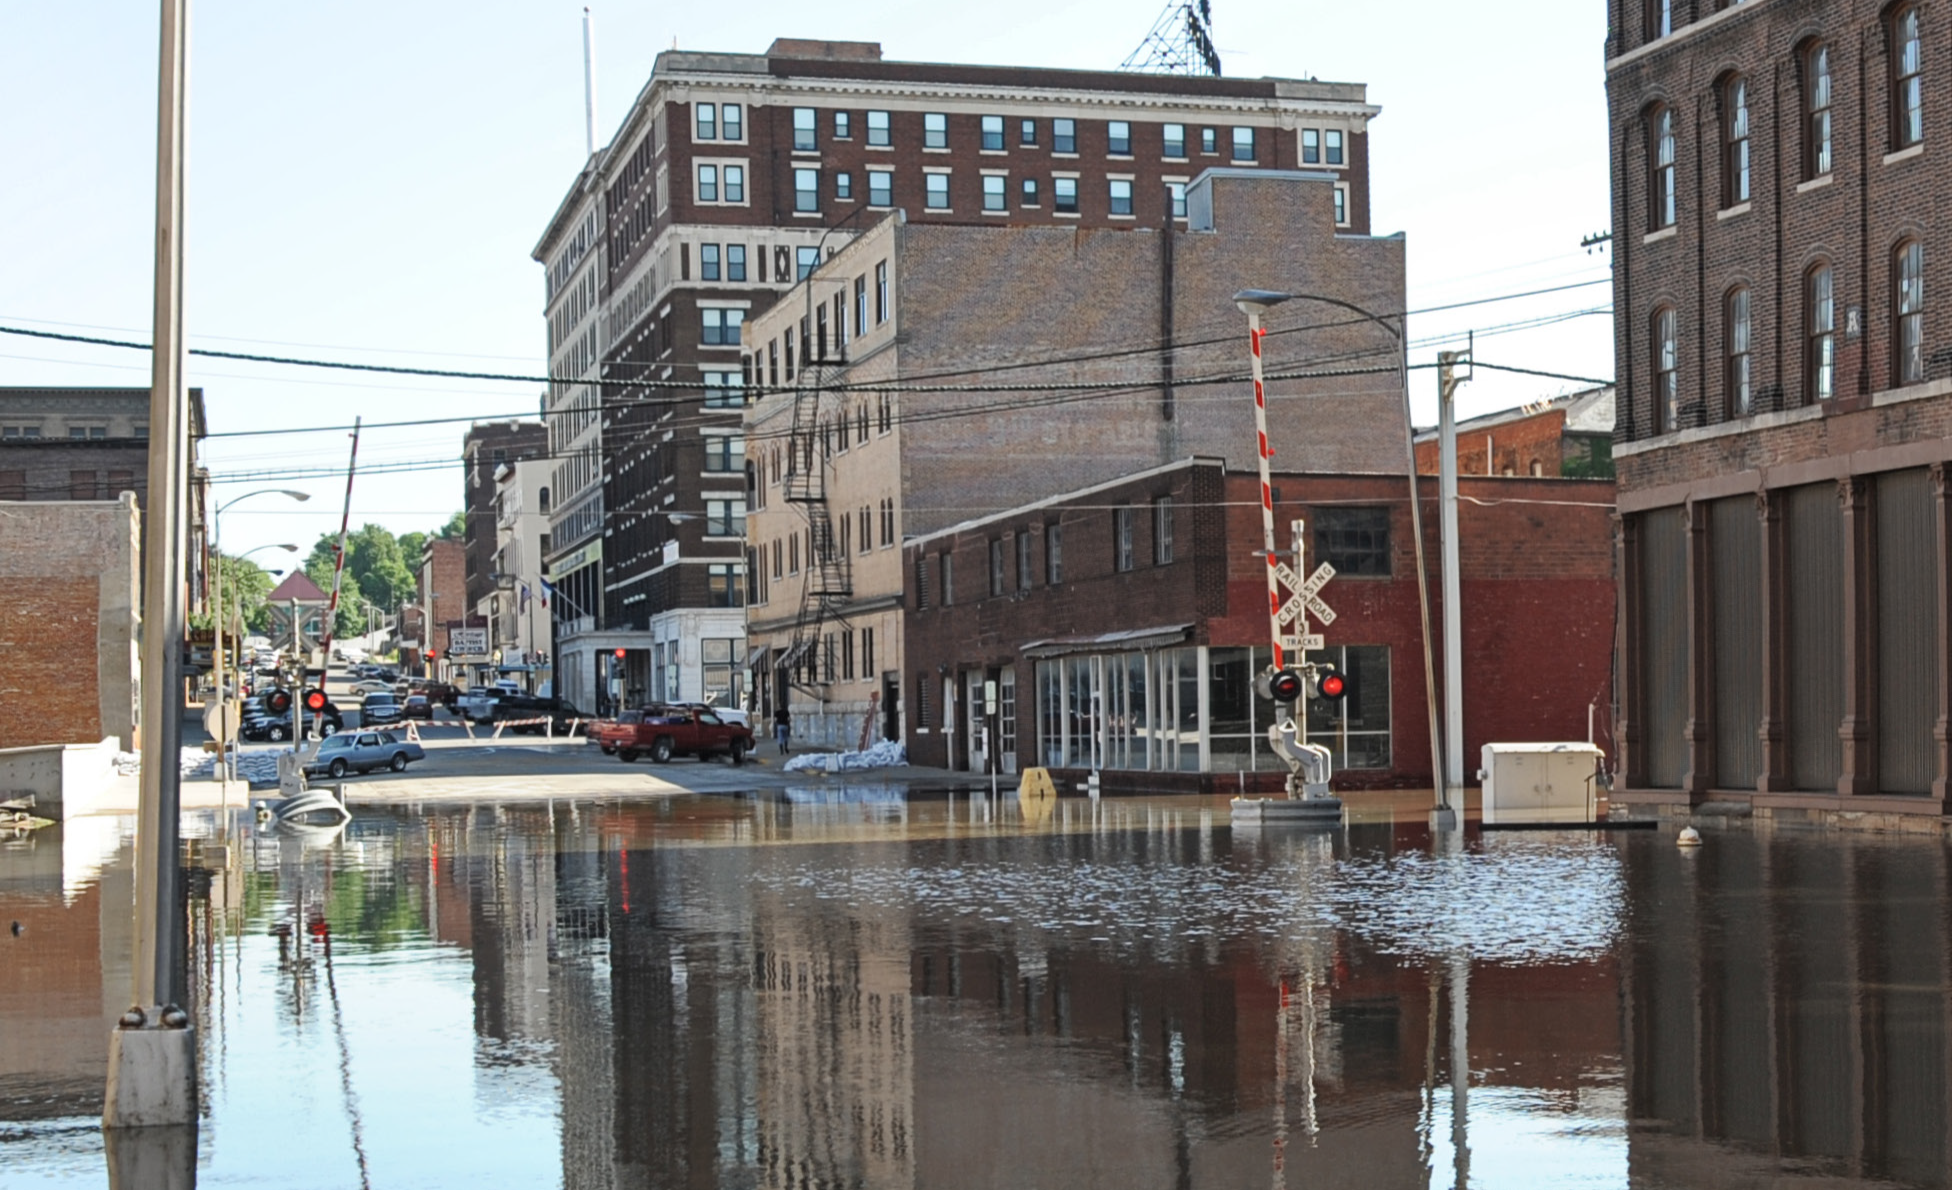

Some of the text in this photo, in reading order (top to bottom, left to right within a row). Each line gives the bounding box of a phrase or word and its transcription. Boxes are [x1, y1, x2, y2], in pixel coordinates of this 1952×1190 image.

[1275, 565, 1333, 622] RAIL ROAD
[1277, 566, 1333, 623] CROSSING
[1286, 638, 1318, 646] TRACKS
